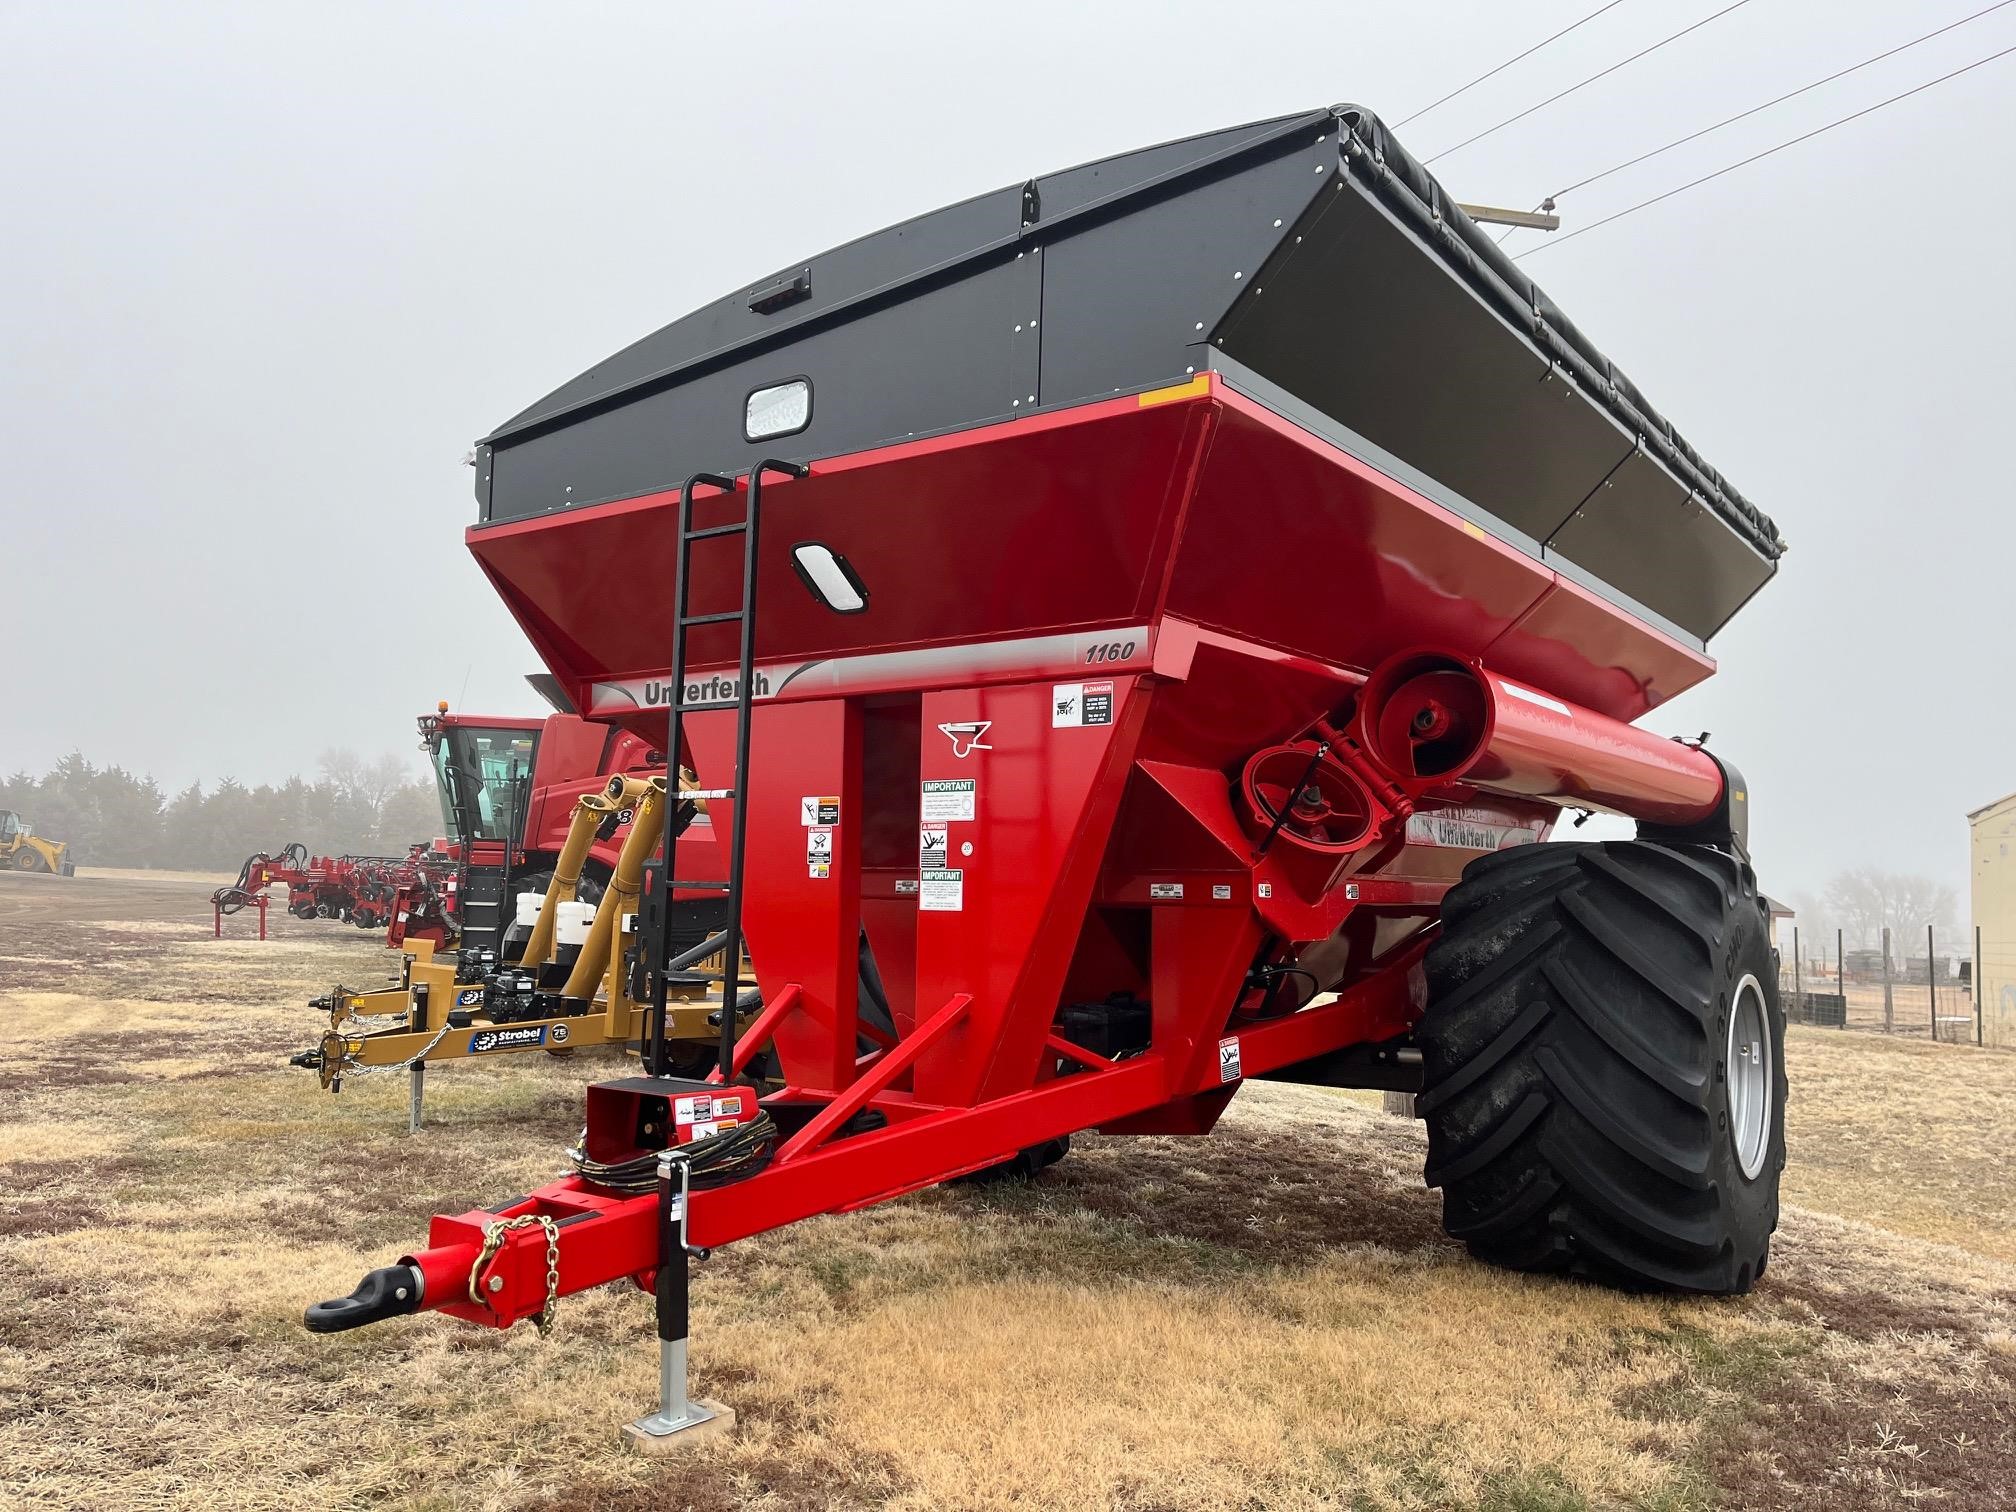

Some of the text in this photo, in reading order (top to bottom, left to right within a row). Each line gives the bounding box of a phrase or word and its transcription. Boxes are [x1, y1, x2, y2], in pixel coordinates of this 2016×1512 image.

[1086, 641, 1136, 664] 1160
[924, 781, 972, 792] IMPORTANT
[922, 871, 961, 881] IMPORTANT
[498, 1028, 541, 1041] Strobel
[553, 1028, 567, 1037] 75
